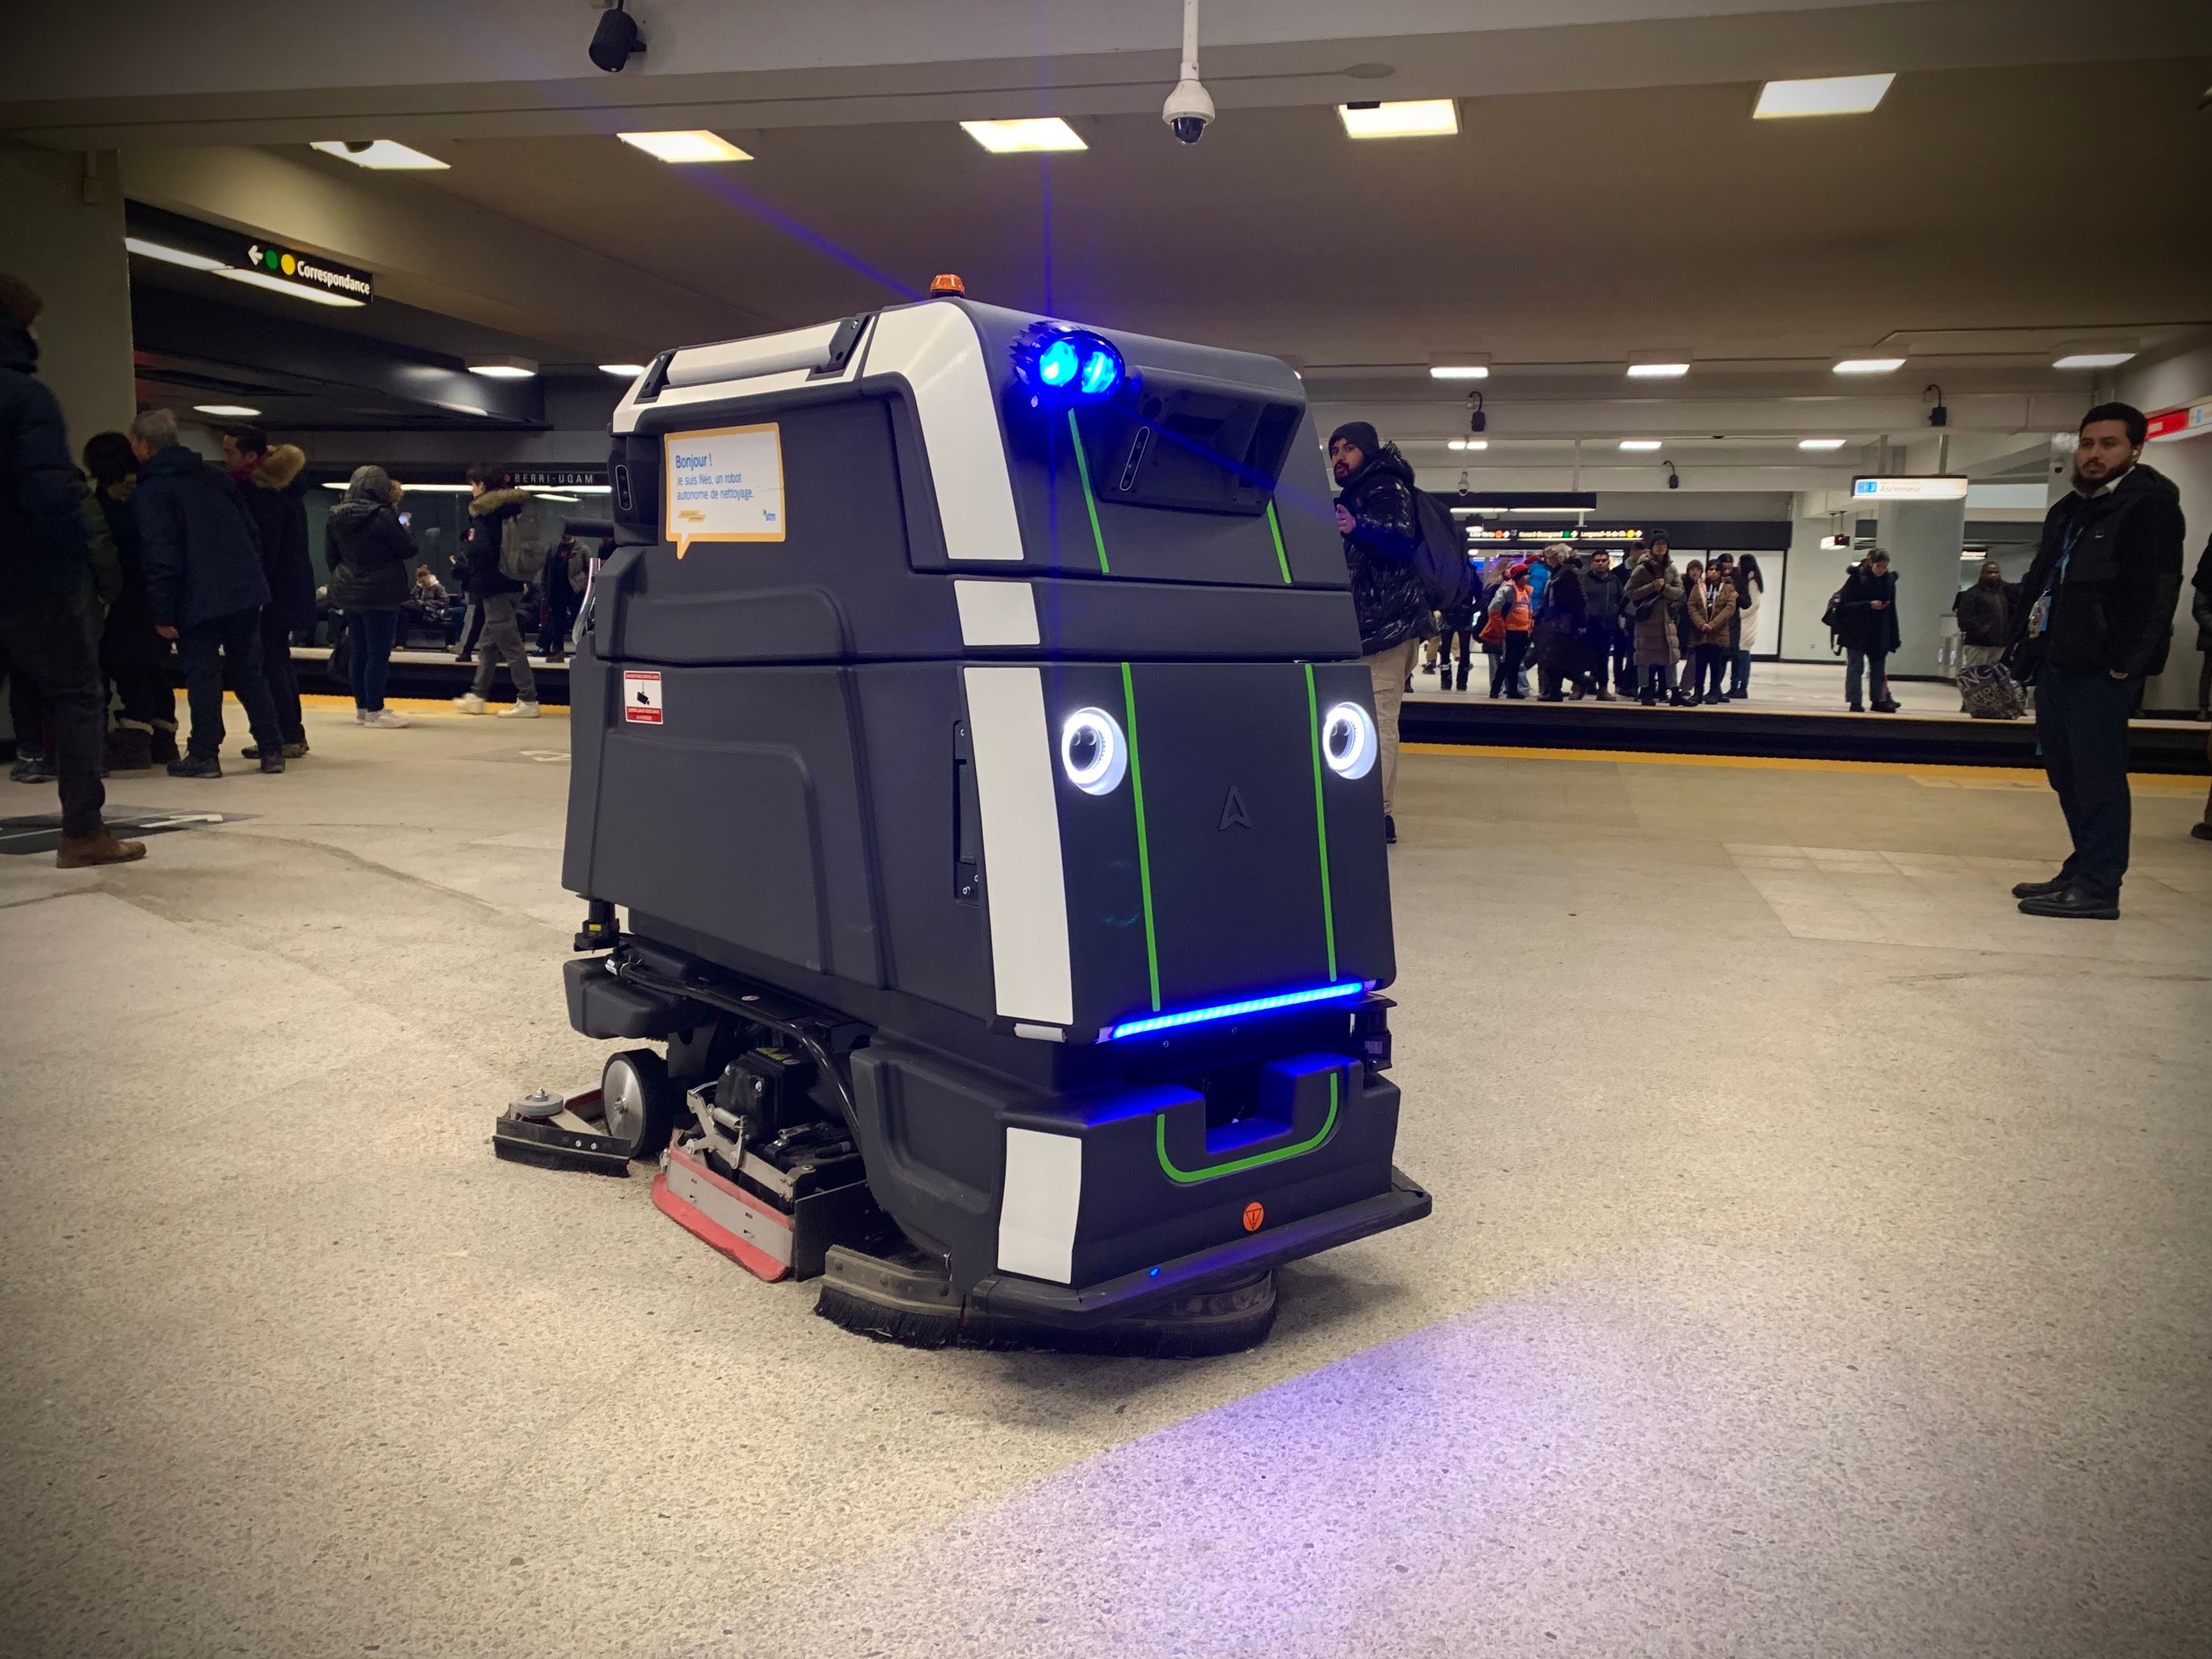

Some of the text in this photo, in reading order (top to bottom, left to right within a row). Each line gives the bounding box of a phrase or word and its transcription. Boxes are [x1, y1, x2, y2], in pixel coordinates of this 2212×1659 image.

[297, 261, 370, 295] Correspondance
[675, 454, 707, 471] Bonjour
[677, 476, 683, 486] Je
[685, 474, 697, 485] suis
[725, 473, 742, 483] robot
[677, 488, 754, 501] autonome de nettoyage.
